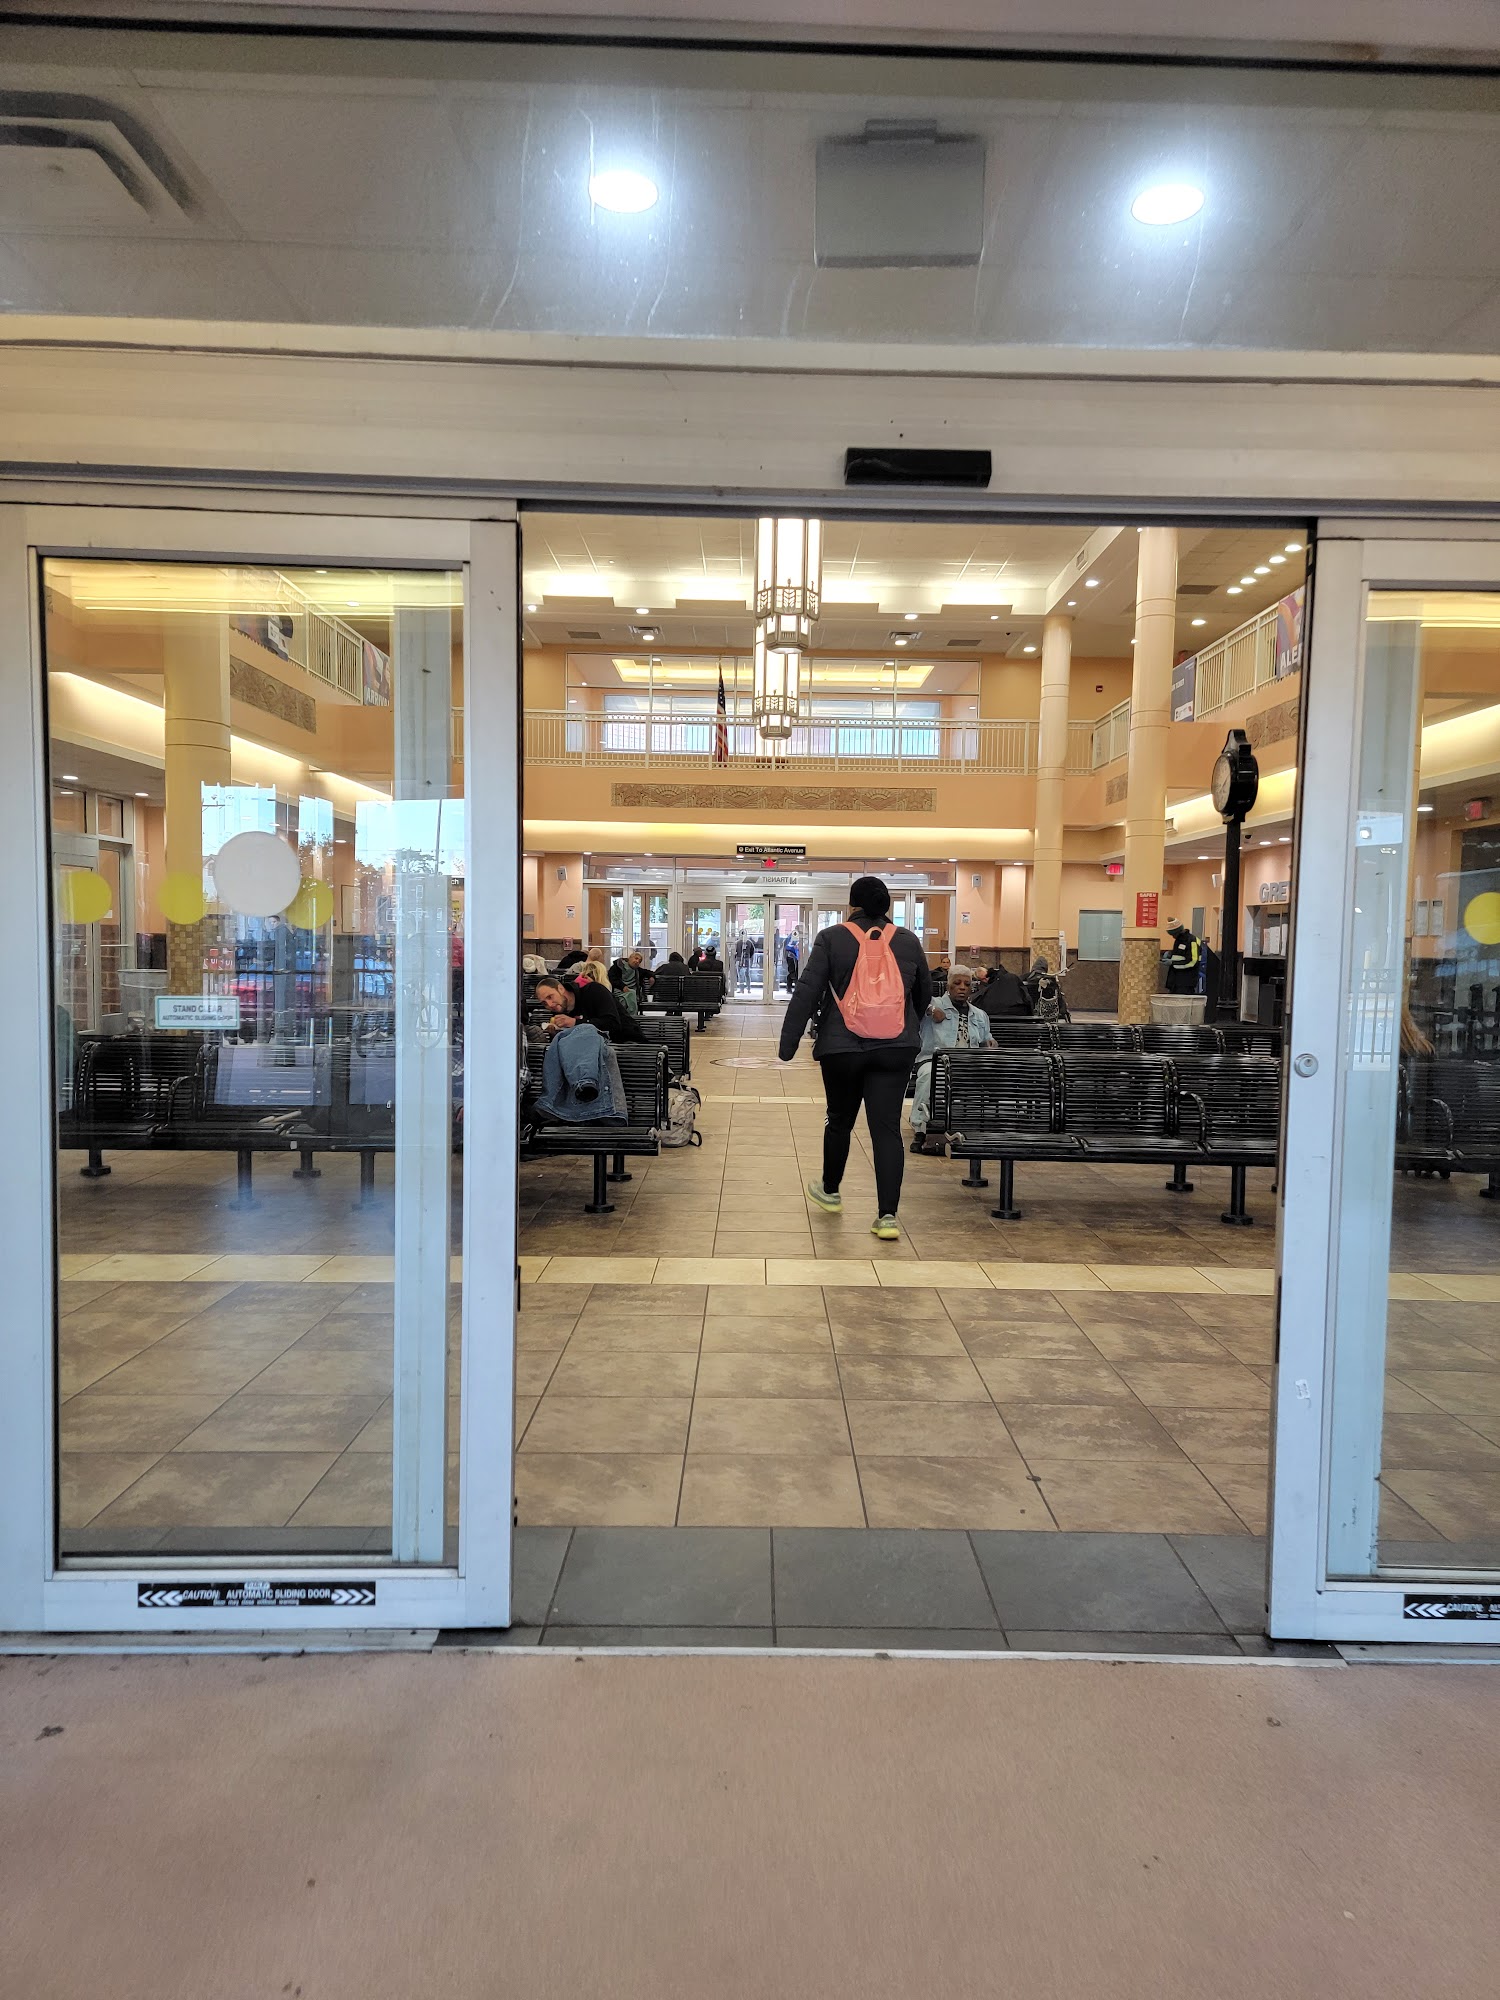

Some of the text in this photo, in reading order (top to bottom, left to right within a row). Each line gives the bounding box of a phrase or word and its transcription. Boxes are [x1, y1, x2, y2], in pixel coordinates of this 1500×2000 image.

[1259, 881, 1290, 904] GRE
[173, 1004, 223, 1013] STAND CEAR
[226, 1589, 273, 1600] AUTOMATIC
[275, 1588, 307, 1599] SLIDING
[308, 1588, 331, 1599] DOOR
